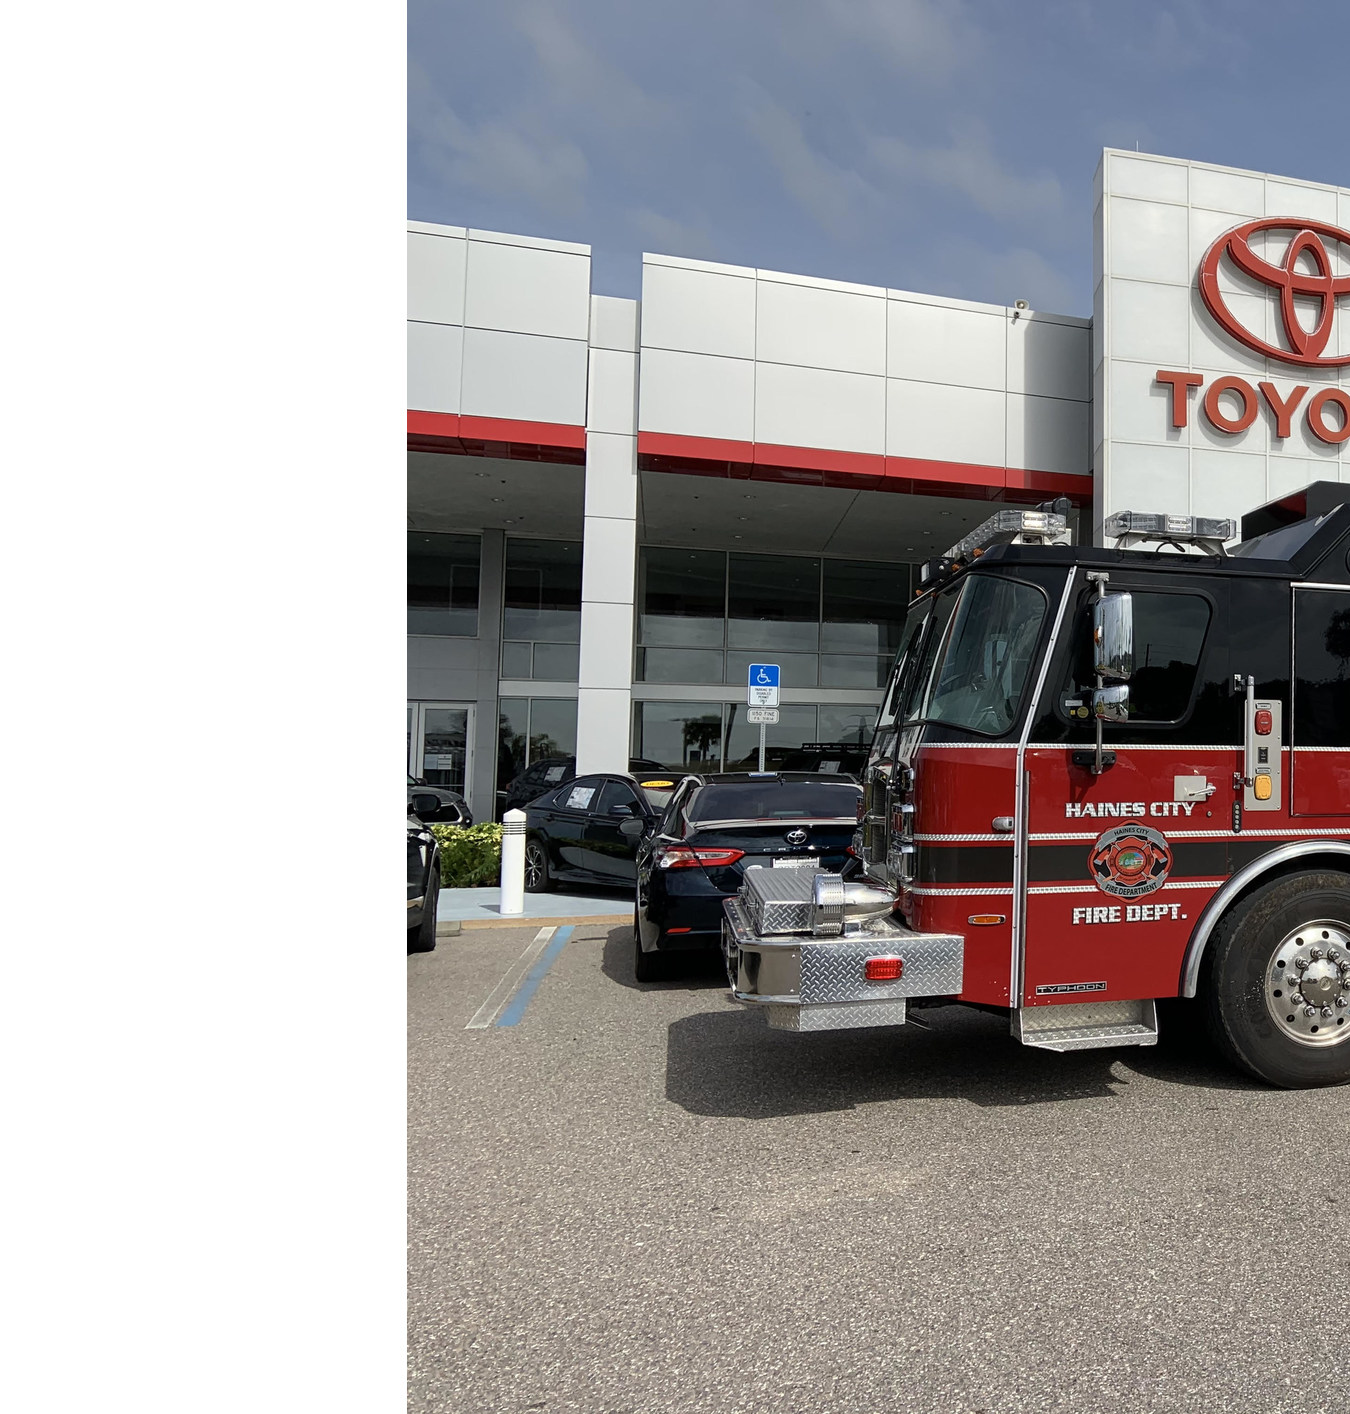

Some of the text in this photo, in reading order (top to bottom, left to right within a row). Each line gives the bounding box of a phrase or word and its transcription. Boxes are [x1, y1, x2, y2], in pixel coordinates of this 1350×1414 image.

[1065, 801, 1196, 818] HAINES CITY
[1113, 827, 1150, 836] HAINES CITY
[1105, 882, 1158, 896] FIRE DEPARTMENT
[1072, 903, 1188, 925] FIRE DEPT.
[1037, 983, 1105, 993] TYPHOON
